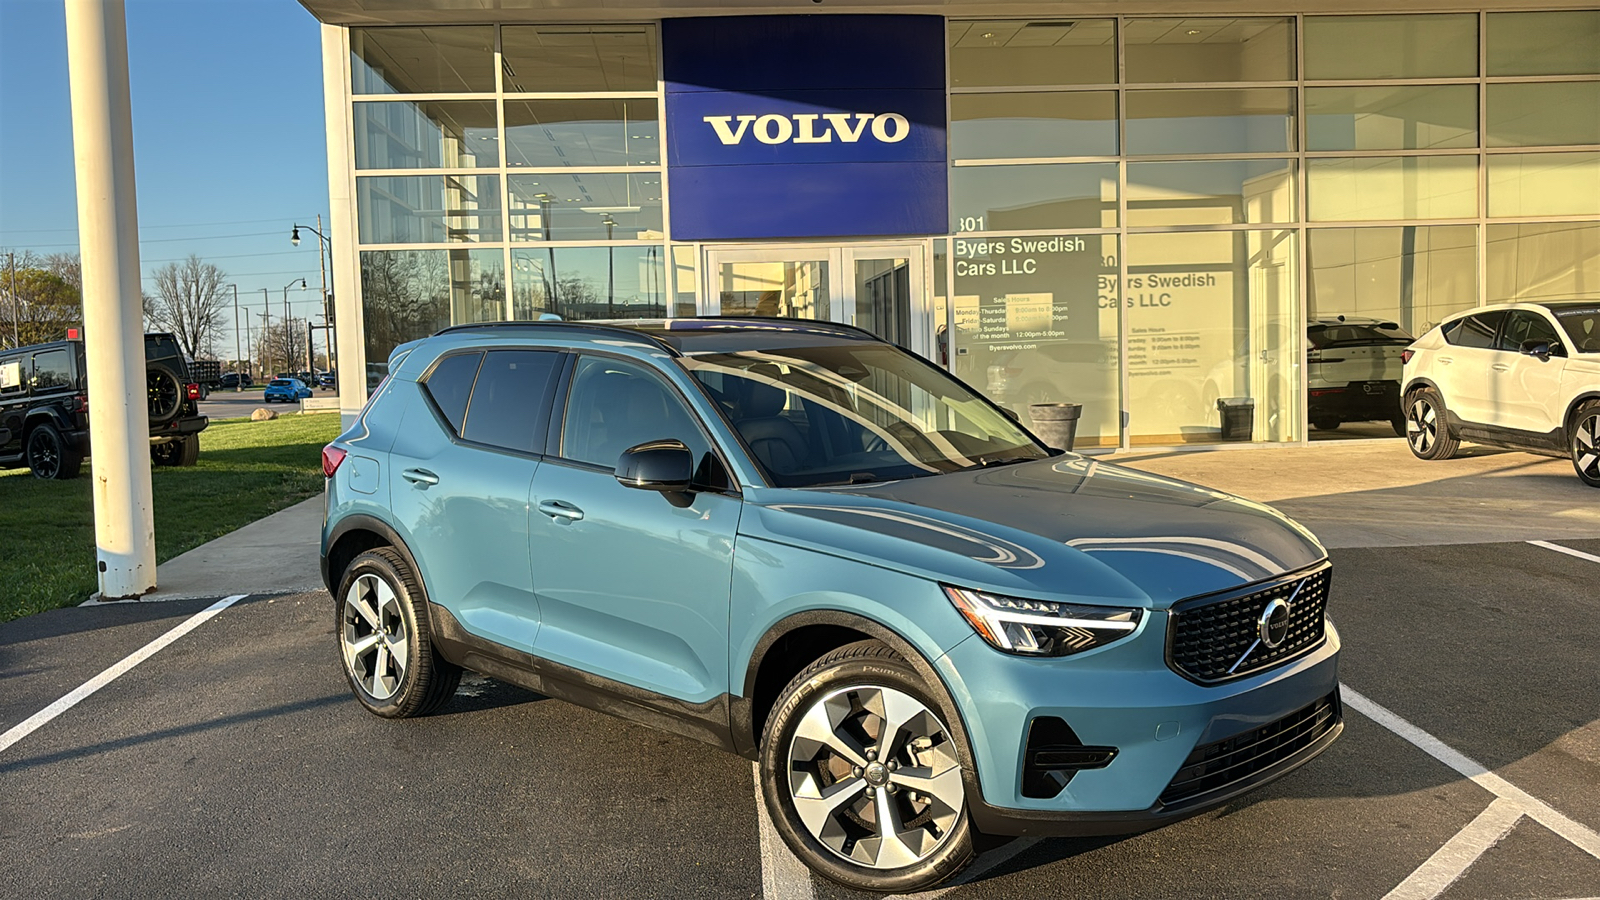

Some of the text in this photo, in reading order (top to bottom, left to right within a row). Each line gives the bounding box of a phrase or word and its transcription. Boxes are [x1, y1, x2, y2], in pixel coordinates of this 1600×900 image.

[703, 112, 909, 144] VOLVO
[956, 237, 1085, 259] Byers Swedish
[956, 259, 1036, 276] Cars LLC
[1098, 273, 1215, 293] Byrs Swedish
[1098, 293, 1171, 308] Cas LLC
[989, 344, 1037, 352] Byersvolvo.com
[1270, 620, 1287, 630] VOLV
